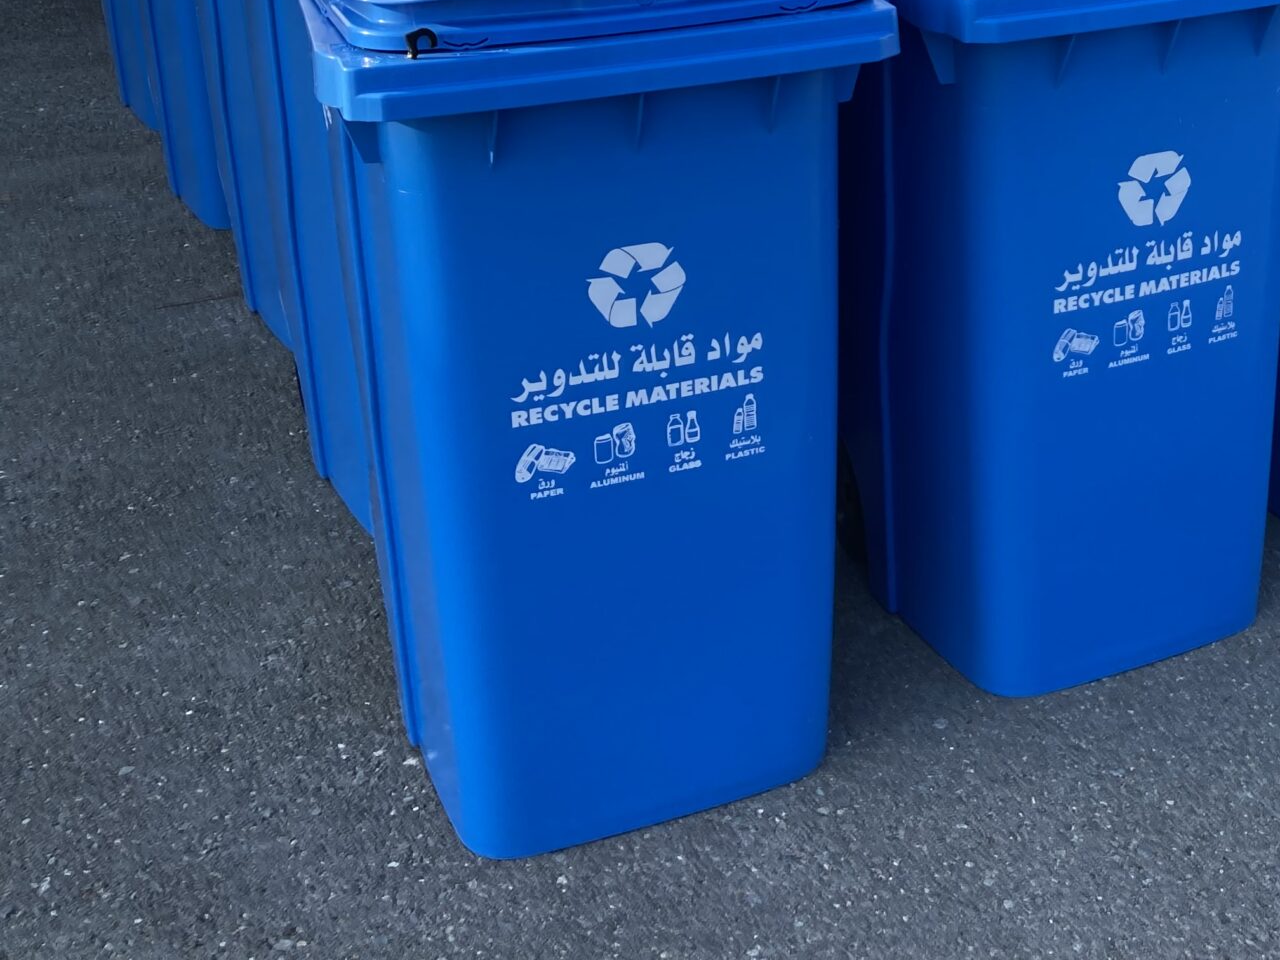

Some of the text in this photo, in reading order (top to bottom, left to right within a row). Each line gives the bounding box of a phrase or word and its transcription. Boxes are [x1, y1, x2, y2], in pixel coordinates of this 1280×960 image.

[1054, 229, 1242, 292] مواد قابلة للتدوير
[1053, 260, 1240, 314] RECYCLE MATERIALS
[1208, 330, 1238, 344] PLASTIC
[1167, 343, 1191, 355] GLASS
[510, 331, 763, 403] مواد قابلة للتدوير
[1108, 353, 1150, 368] ALUMINUM
[1063, 367, 1089, 378] PAPER
[511, 366, 764, 428] RECYCLE MATERIALS
[729, 434, 762, 449] بلاستيك
[674, 447, 696, 462] زجاج
[725, 445, 766, 461] PLASTIC
[668, 460, 702, 473] GLASS
[538, 478, 555, 490] ورق
[590, 471, 645, 489] ALUMINUM
[530, 487, 564, 500] PAPER
